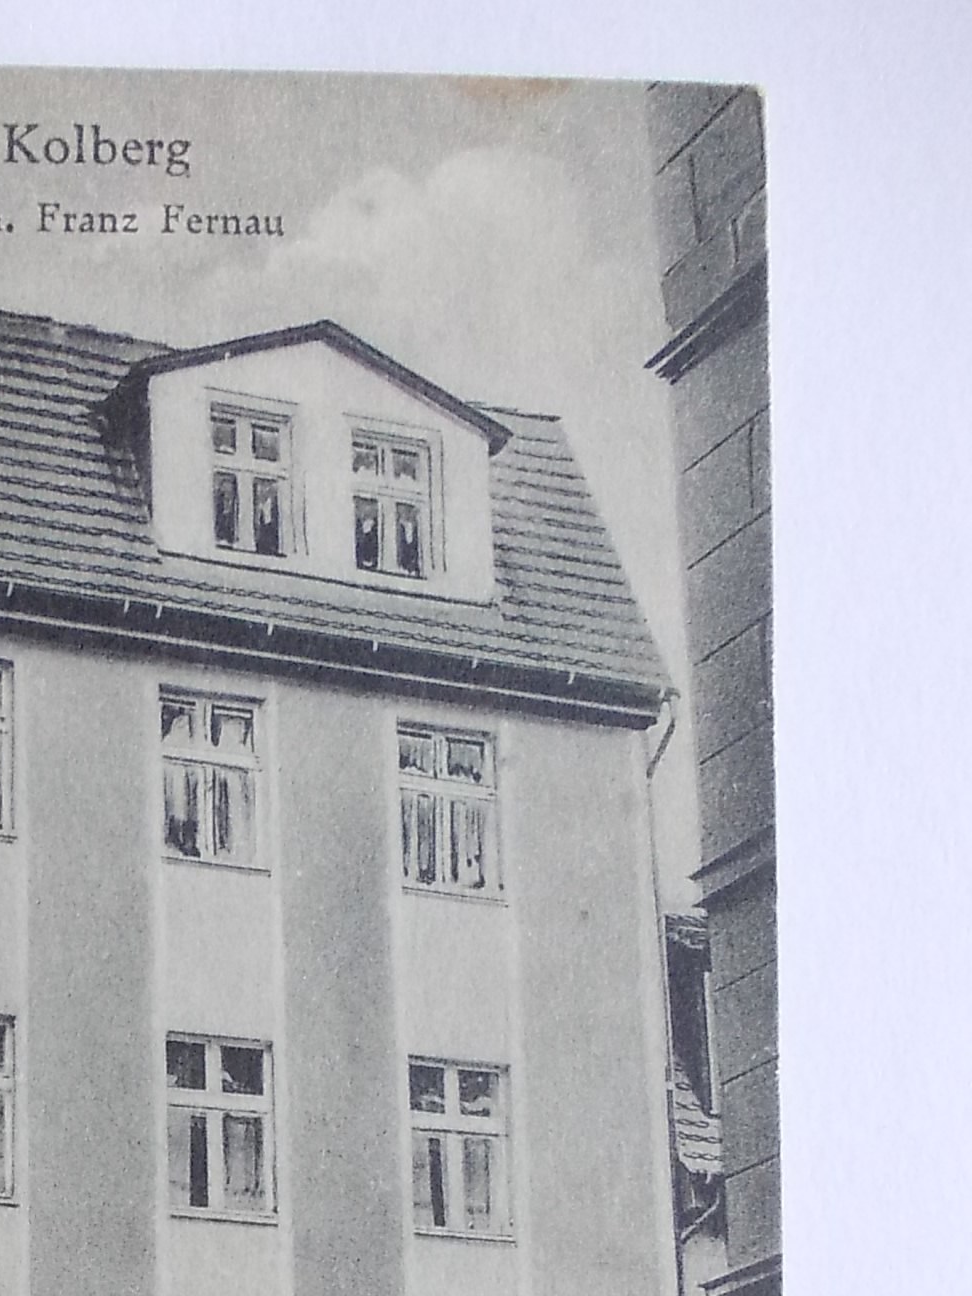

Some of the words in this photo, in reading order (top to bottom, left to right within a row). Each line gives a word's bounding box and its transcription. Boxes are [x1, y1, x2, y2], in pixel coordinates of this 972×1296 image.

[2, 122, 193, 178] Kolberg
[37, 202, 139, 234] Franz
[161, 204, 285, 237] Fernau
